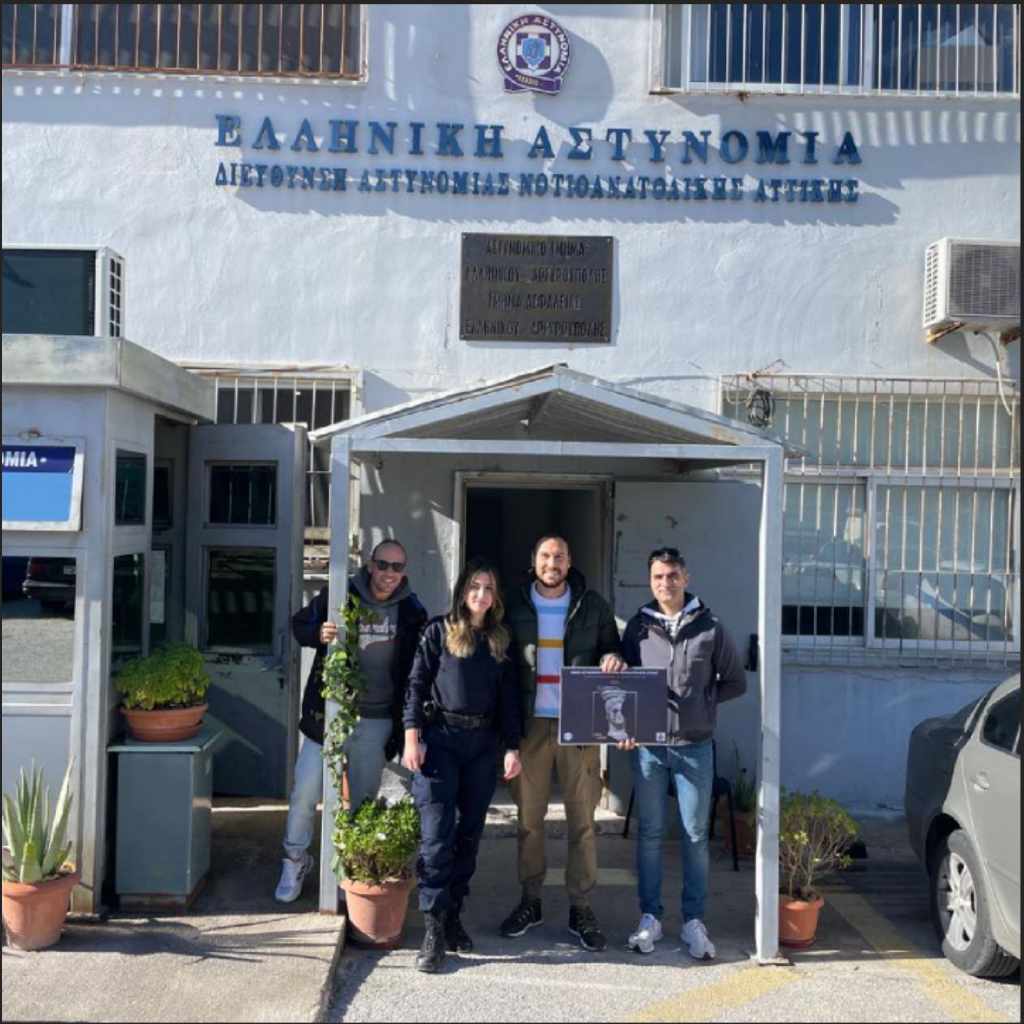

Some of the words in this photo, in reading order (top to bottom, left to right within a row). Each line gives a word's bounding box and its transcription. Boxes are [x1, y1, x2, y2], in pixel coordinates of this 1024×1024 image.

[215, 114, 505, 158] ΕΛΛΗΝΙΚΗ
[528, 125, 862, 165] ΑΣΤΥΝΟΜΙΑ
[215, 162, 347, 191] ΔΙΕΥΘΥΝΣΗ
[357, 168, 510, 197] ΑΣΤΥΝΟΜΙΑΣ
[519, 172, 744, 201] ΝΟΤΙΟΑΝΑΤΟΛΙΚΗΣ
[754, 178, 860, 203] ΑΤΤΙΚΗΣ
[2, 451, 38, 467] ΜΙΑ
